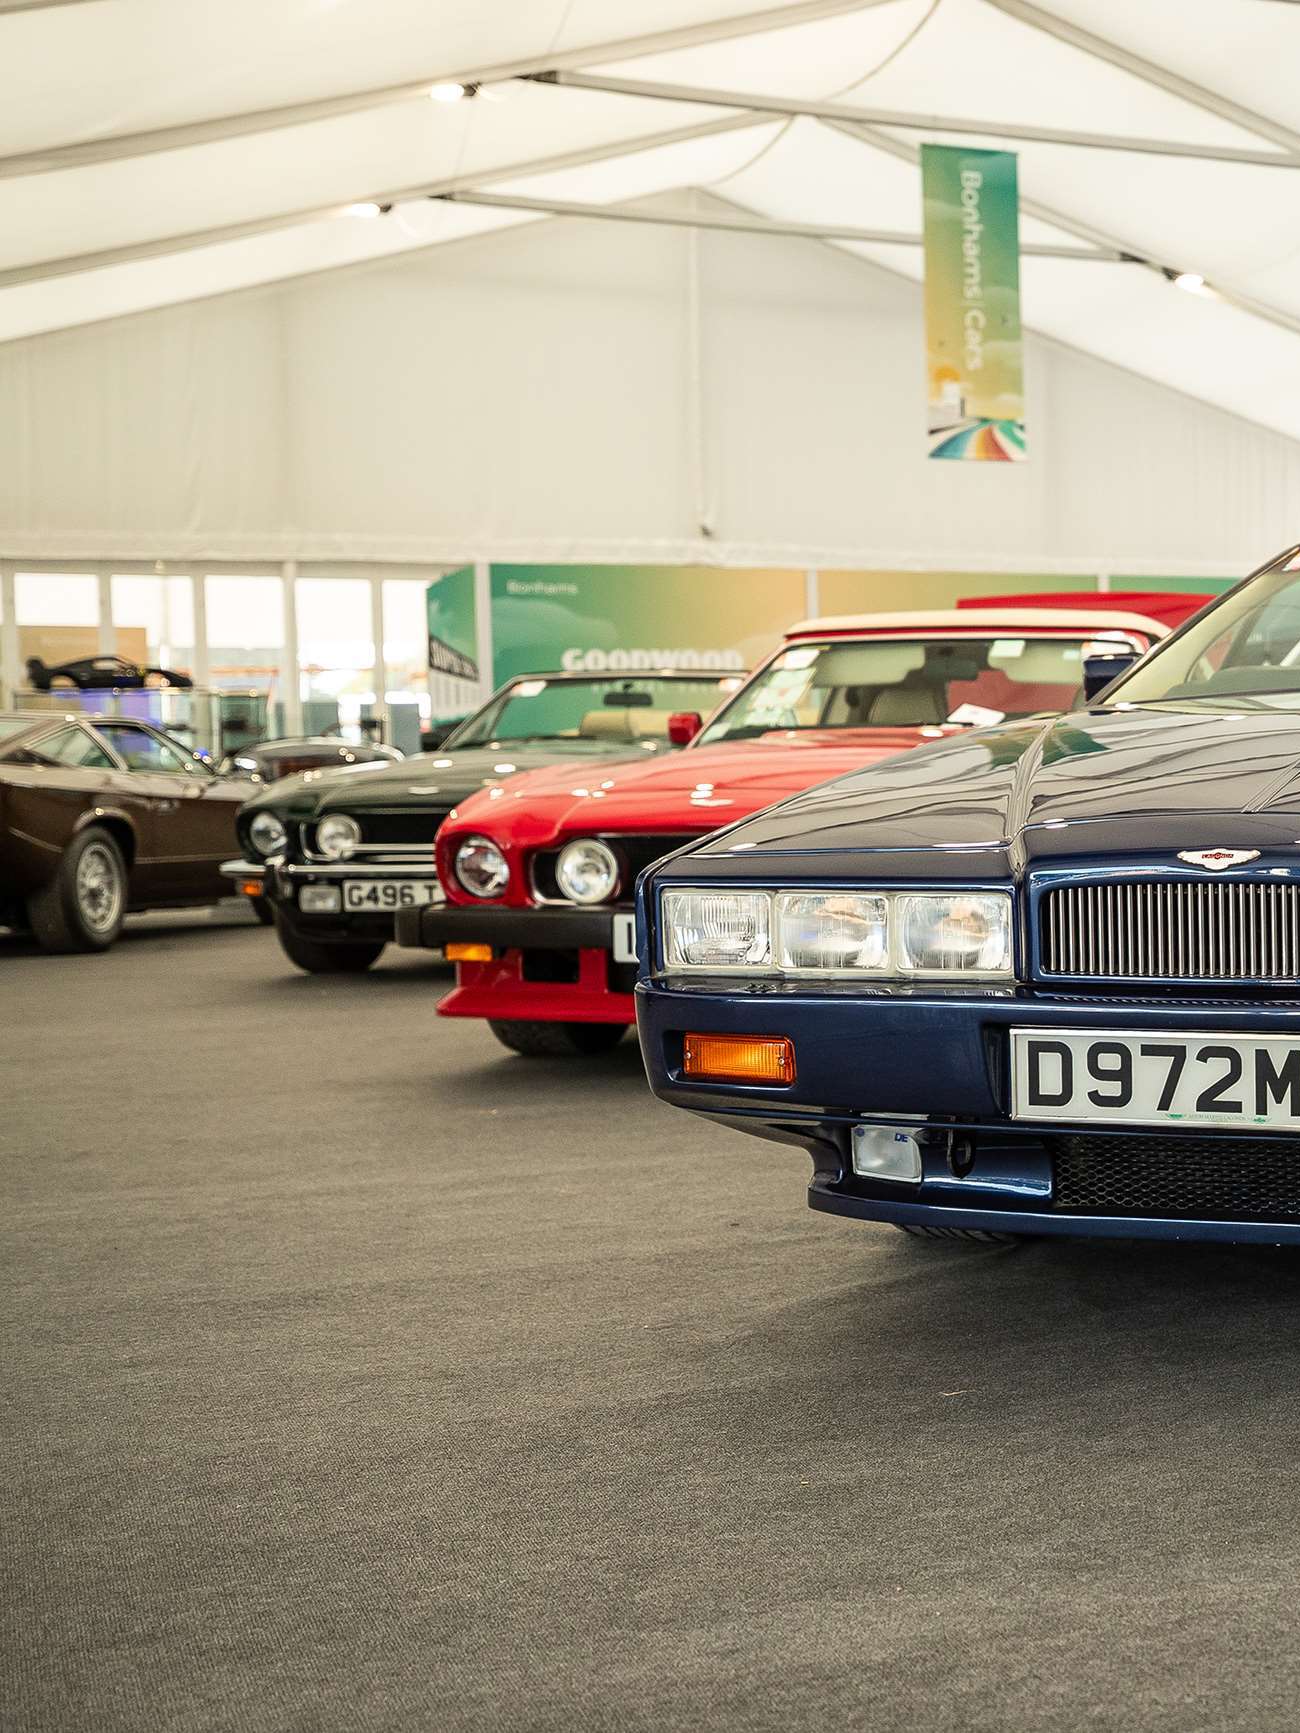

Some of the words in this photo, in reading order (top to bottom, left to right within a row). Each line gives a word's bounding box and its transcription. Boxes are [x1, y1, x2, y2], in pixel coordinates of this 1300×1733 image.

[561, 648, 744, 671] GOODWOOD
[348, 885, 415, 905] G496
[894, 1132, 909, 1143] DE
